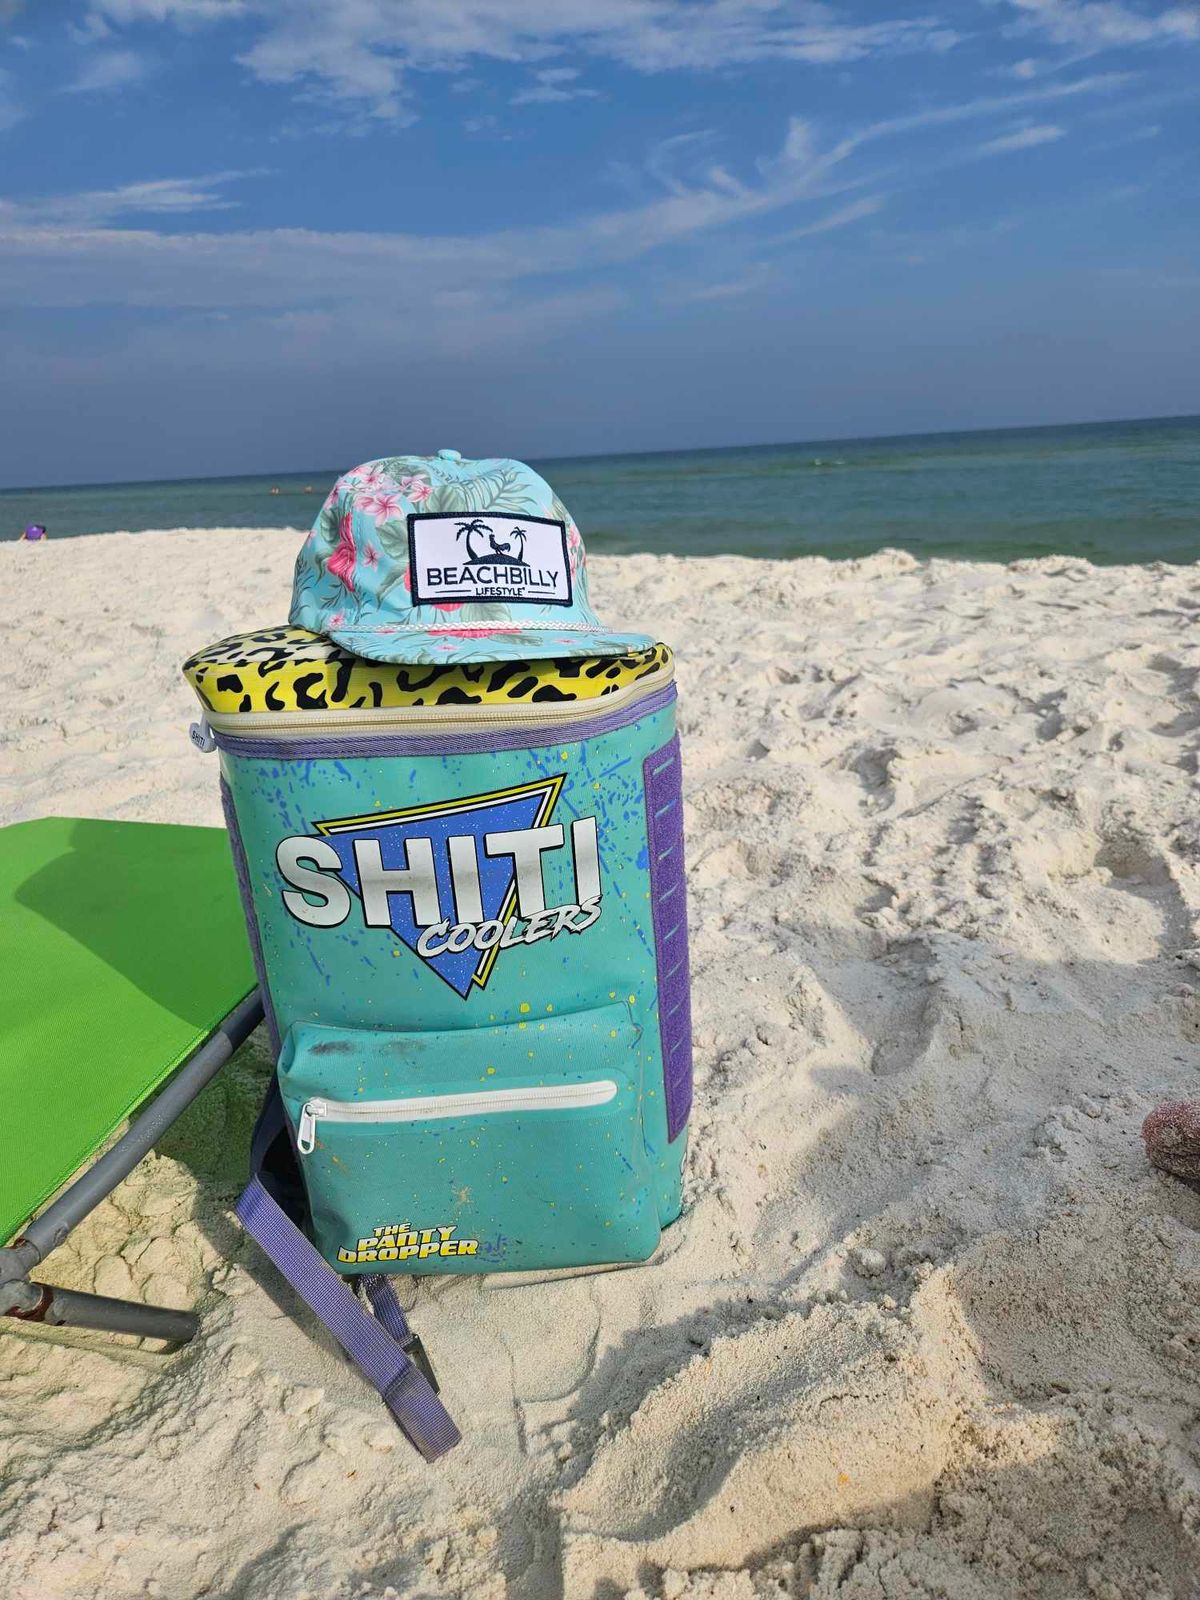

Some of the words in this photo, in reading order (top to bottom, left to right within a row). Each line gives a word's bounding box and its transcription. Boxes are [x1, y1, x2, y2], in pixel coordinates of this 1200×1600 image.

[426, 566, 559, 588] BEACHBILLY
[475, 586, 524, 596] LIFESTYLE
[275, 816, 602, 928] SHITI
[416, 894, 604, 959] COOLERS
[357, 1225, 458, 1251] PANTY
[373, 1222, 412, 1237] THE
[337, 1239, 479, 1263] DROPPER
